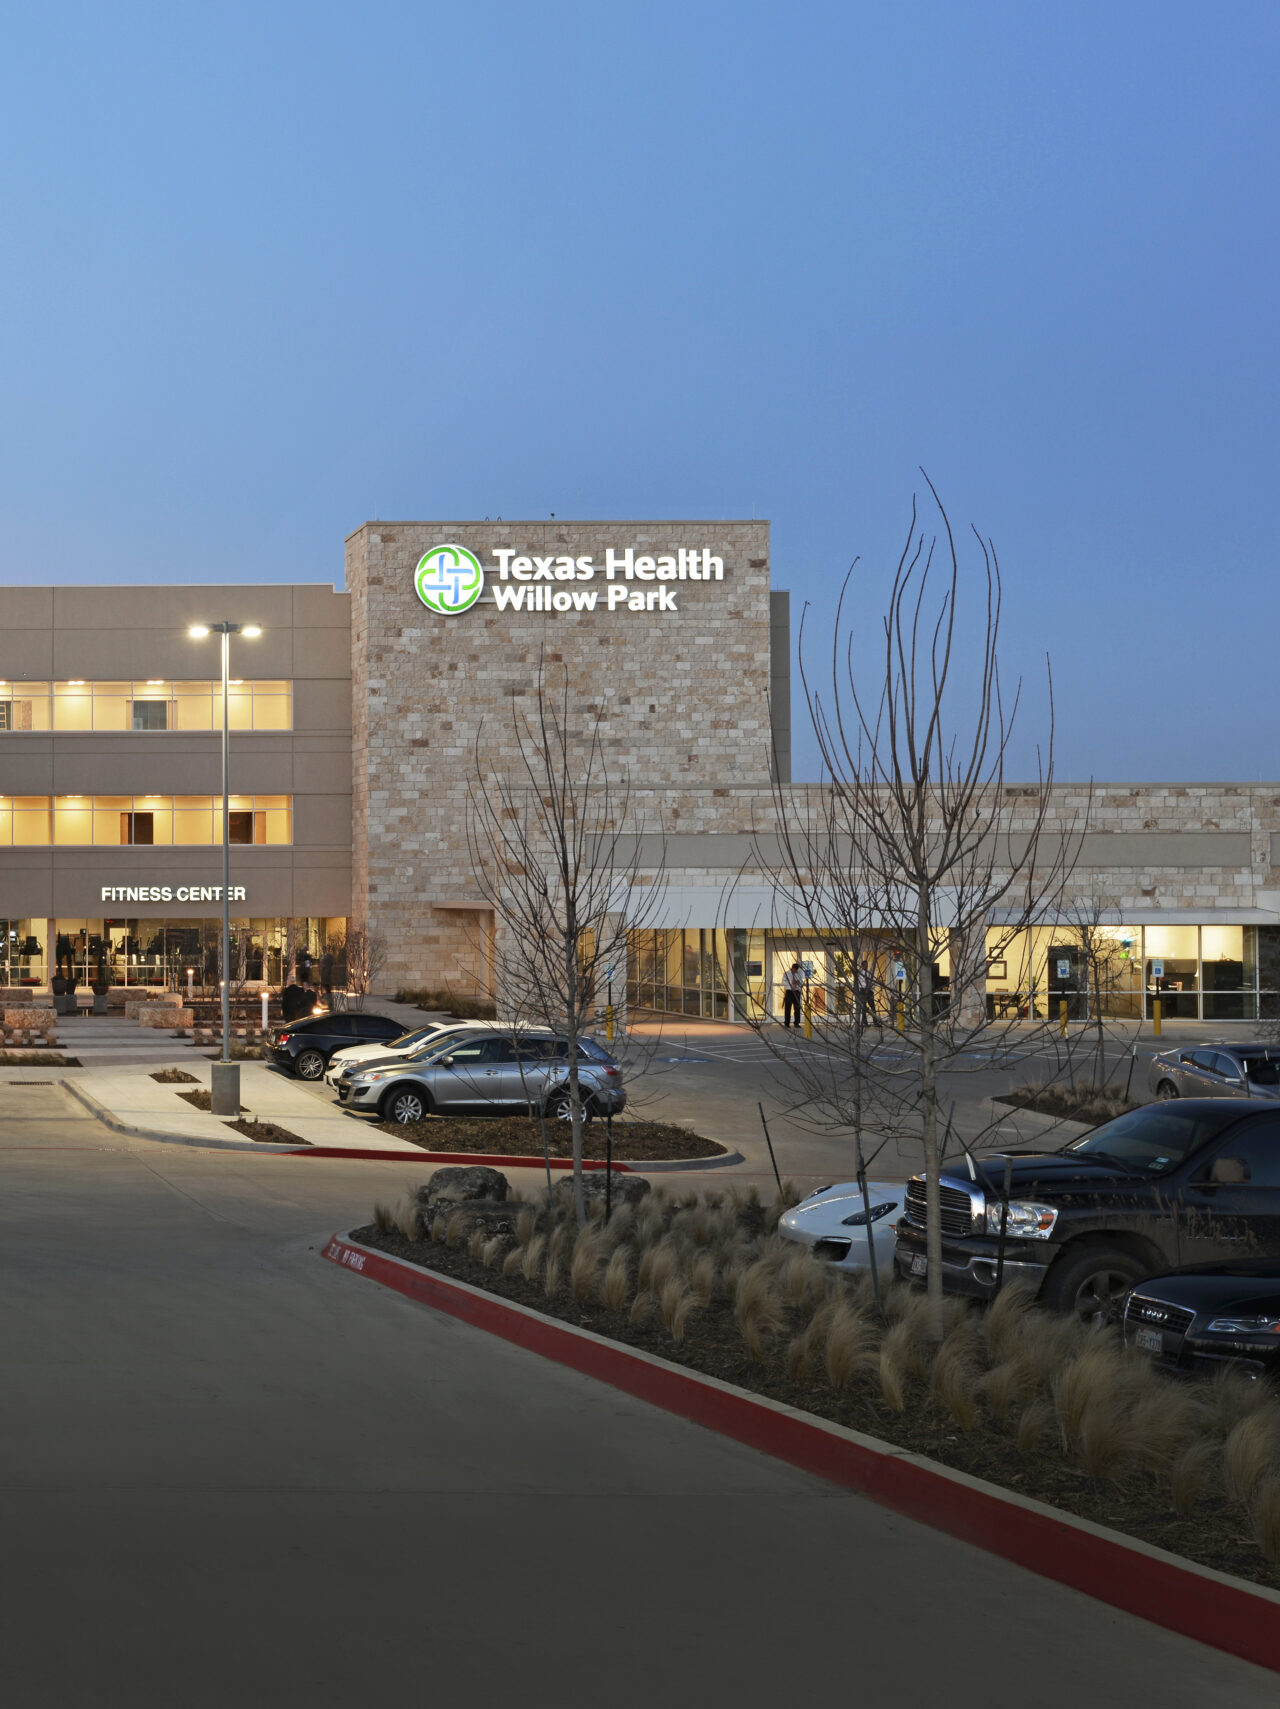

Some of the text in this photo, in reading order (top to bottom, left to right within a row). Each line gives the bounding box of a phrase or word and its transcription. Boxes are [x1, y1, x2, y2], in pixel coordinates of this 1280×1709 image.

[492, 548, 724, 581] Texas Health
[492, 585, 678, 612] Willow Park
[101, 887, 172, 901] FITNESS
